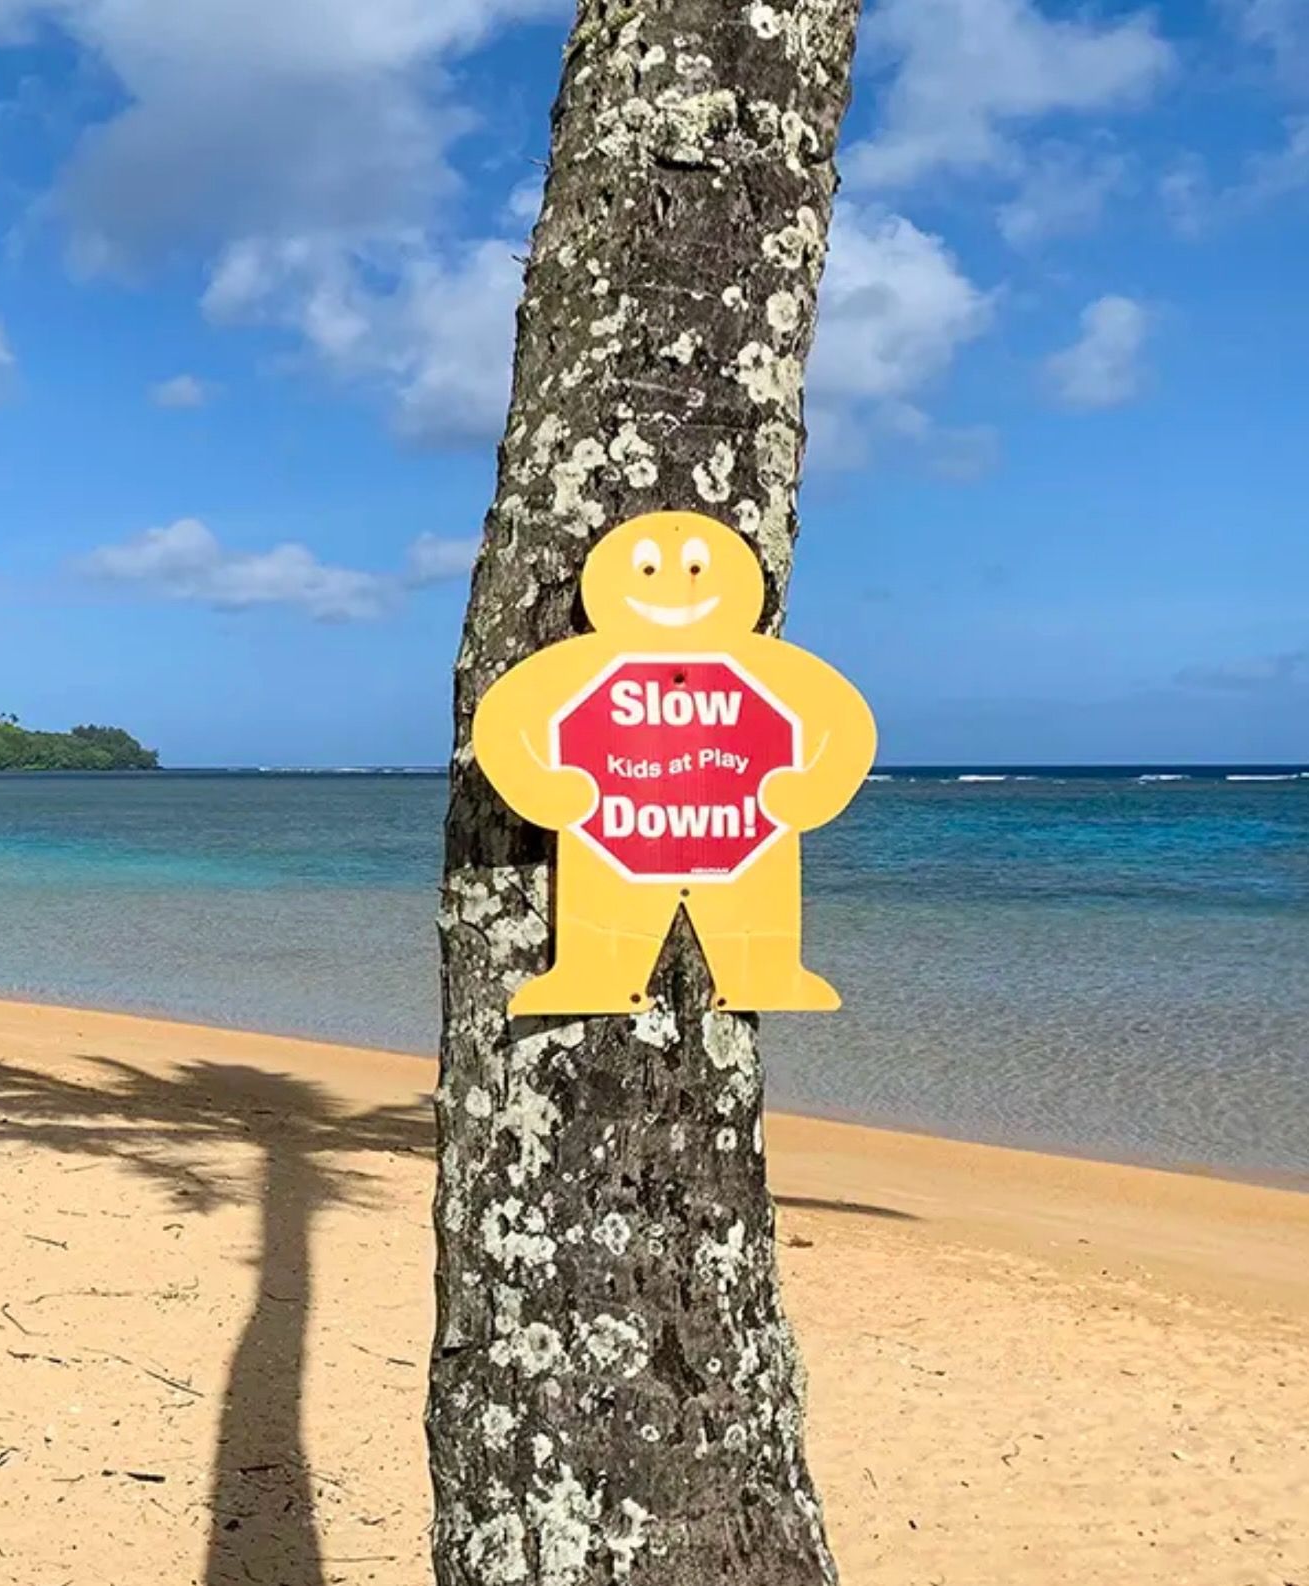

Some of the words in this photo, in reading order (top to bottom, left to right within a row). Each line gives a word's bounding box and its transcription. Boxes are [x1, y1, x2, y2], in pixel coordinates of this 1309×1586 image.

[610, 680, 742, 726] Slow
[607, 754, 661, 779] Kids
[668, 753, 692, 774] at
[699, 748, 749, 773] Play
[602, 795, 757, 838] Down!
